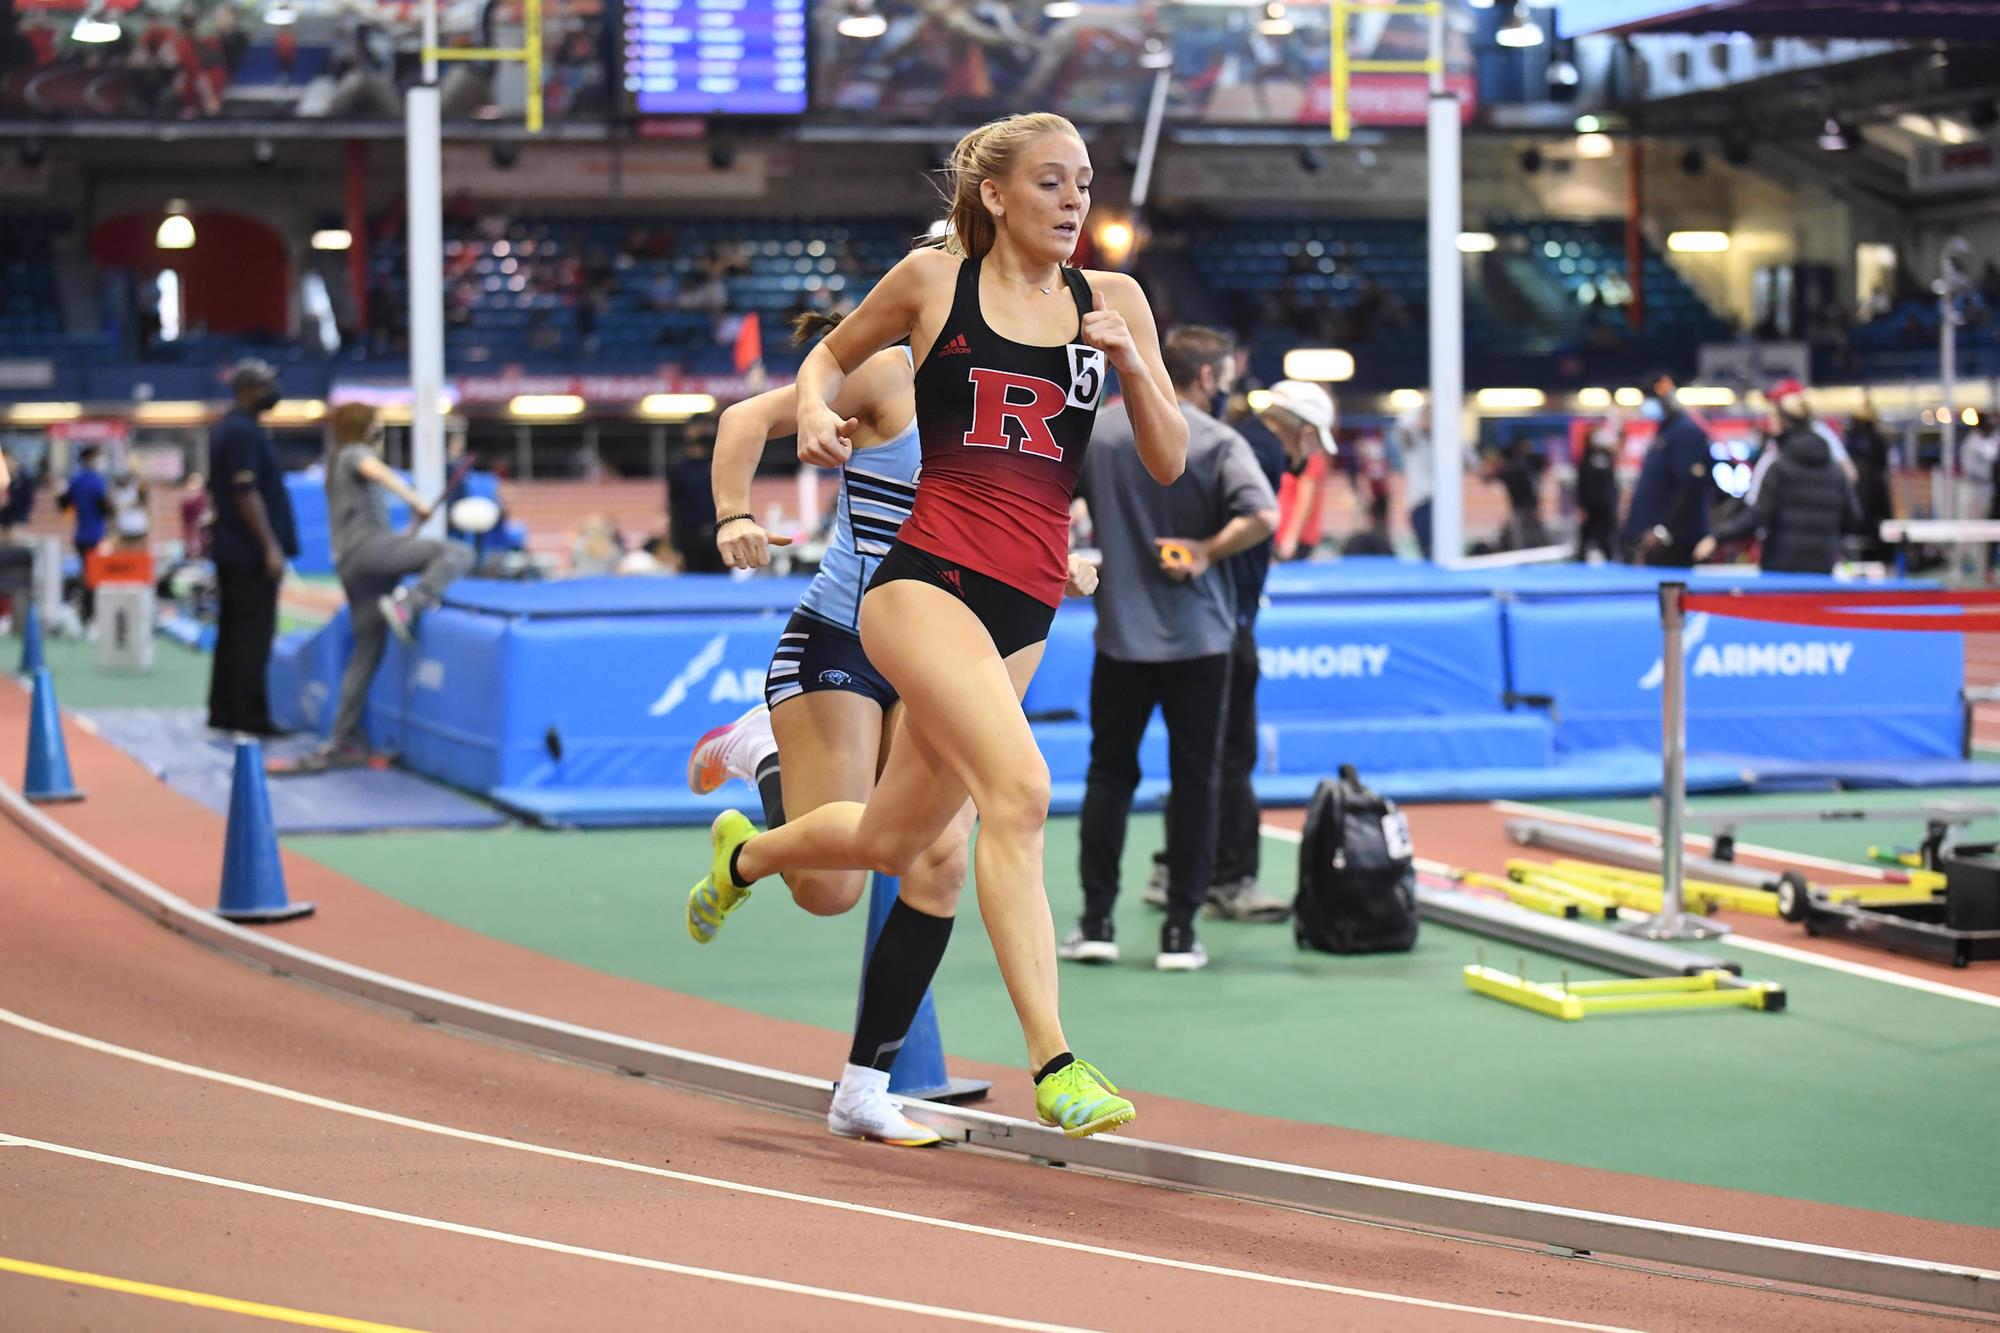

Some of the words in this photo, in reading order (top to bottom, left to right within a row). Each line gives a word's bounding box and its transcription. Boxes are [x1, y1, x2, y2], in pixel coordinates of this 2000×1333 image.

[1074, 348, 1099, 404] 5
[964, 367, 1067, 462] R
[1258, 644, 1390, 679] RMORY
[1693, 641, 1854, 677] ARMORY
